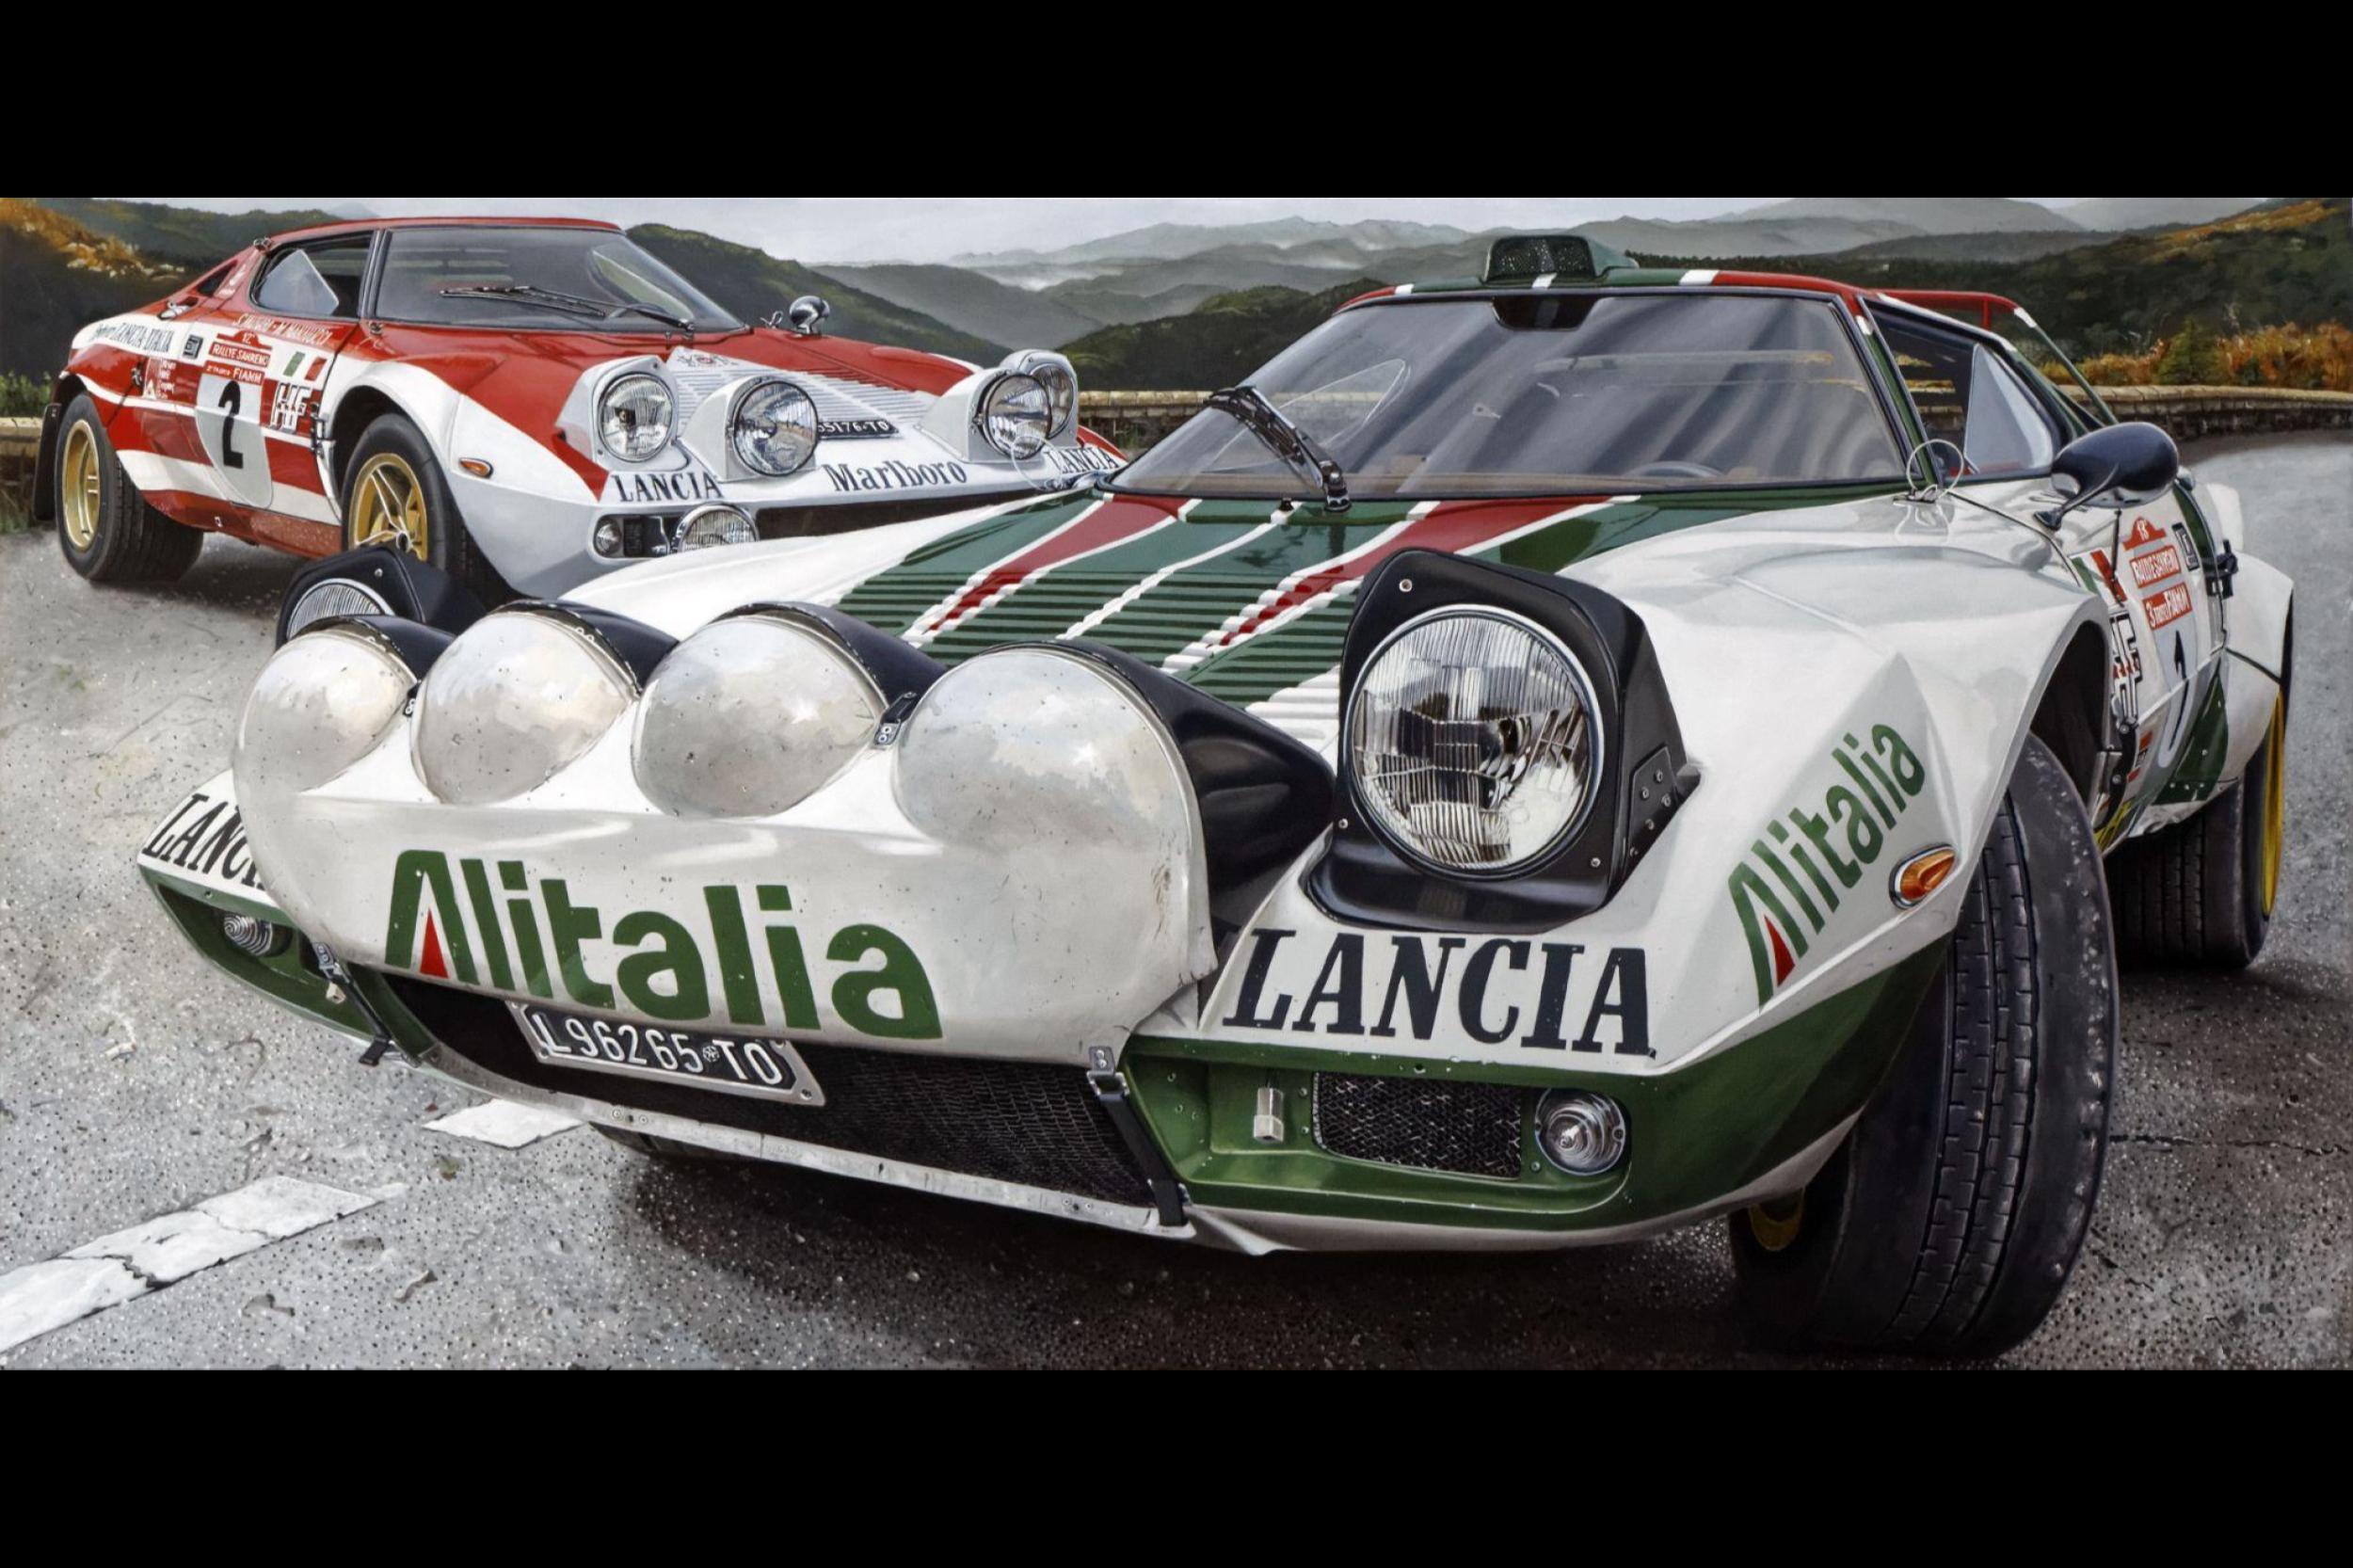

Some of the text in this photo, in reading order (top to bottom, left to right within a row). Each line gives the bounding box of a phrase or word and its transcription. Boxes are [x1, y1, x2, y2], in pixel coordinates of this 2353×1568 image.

[217, 380, 244, 469] 2
[1043, 447, 1120, 474] LANCIA
[610, 472, 724, 503] LANCIA
[822, 460, 968, 492] Marlboro
[141, 792, 265, 891] LANC
[1727, 723, 1927, 1011] Alitalia
[385, 849, 943, 1041] Alitalia
[1222, 926, 1657, 1061] LANCIA
[712, 1038, 783, 1086] TO
